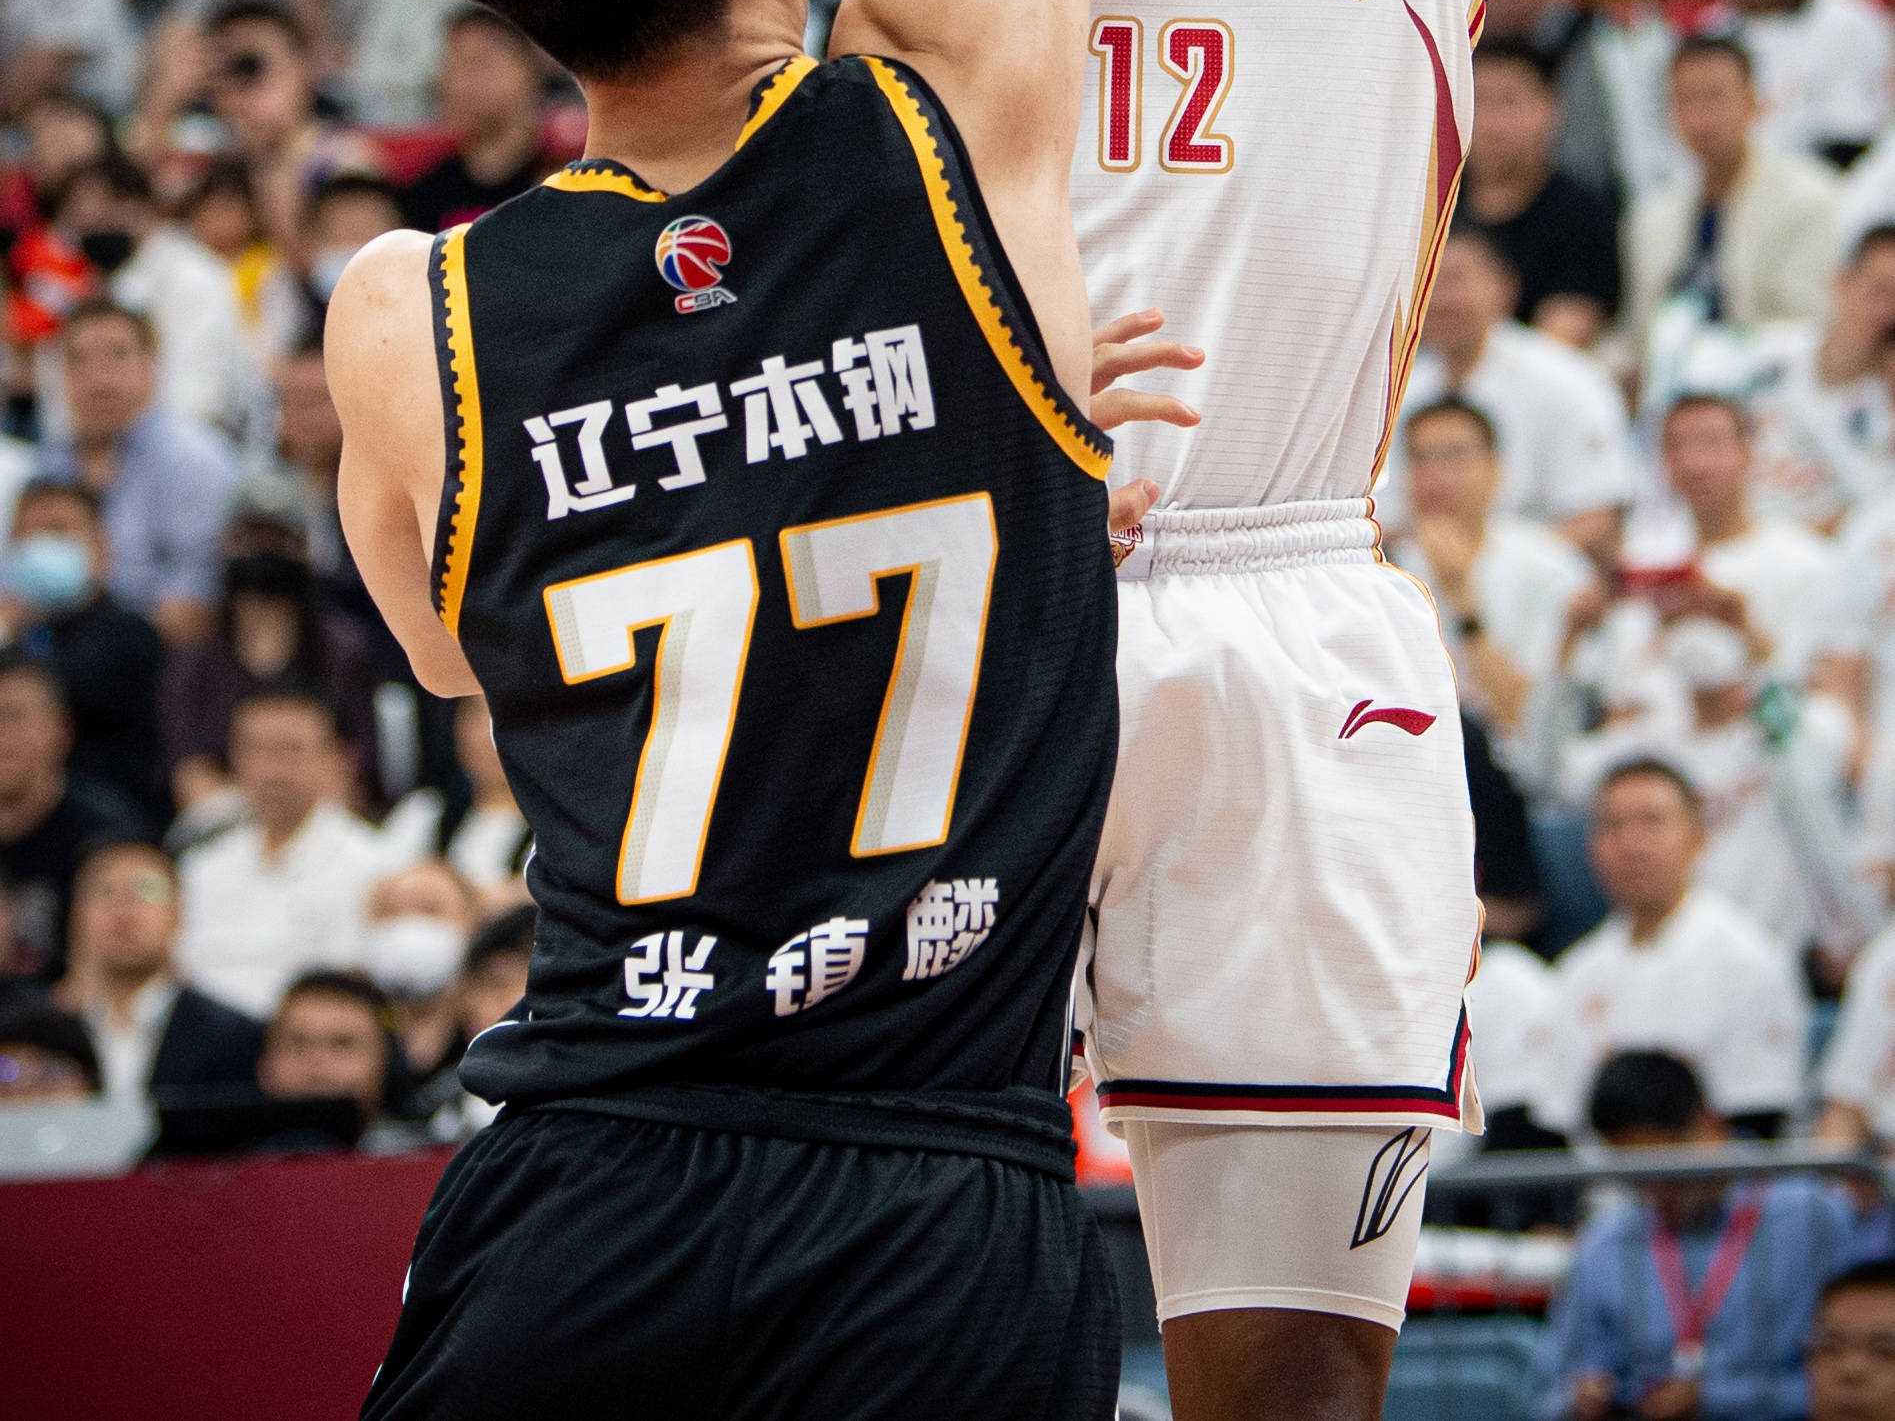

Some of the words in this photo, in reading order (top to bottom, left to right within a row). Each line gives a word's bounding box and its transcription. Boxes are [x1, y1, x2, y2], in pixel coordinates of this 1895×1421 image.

[1088, 15, 1234, 173] 12
[675, 286, 738, 314] CBA
[523, 324, 935, 520] 辽宁本钢
[543, 491, 998, 905] 77
